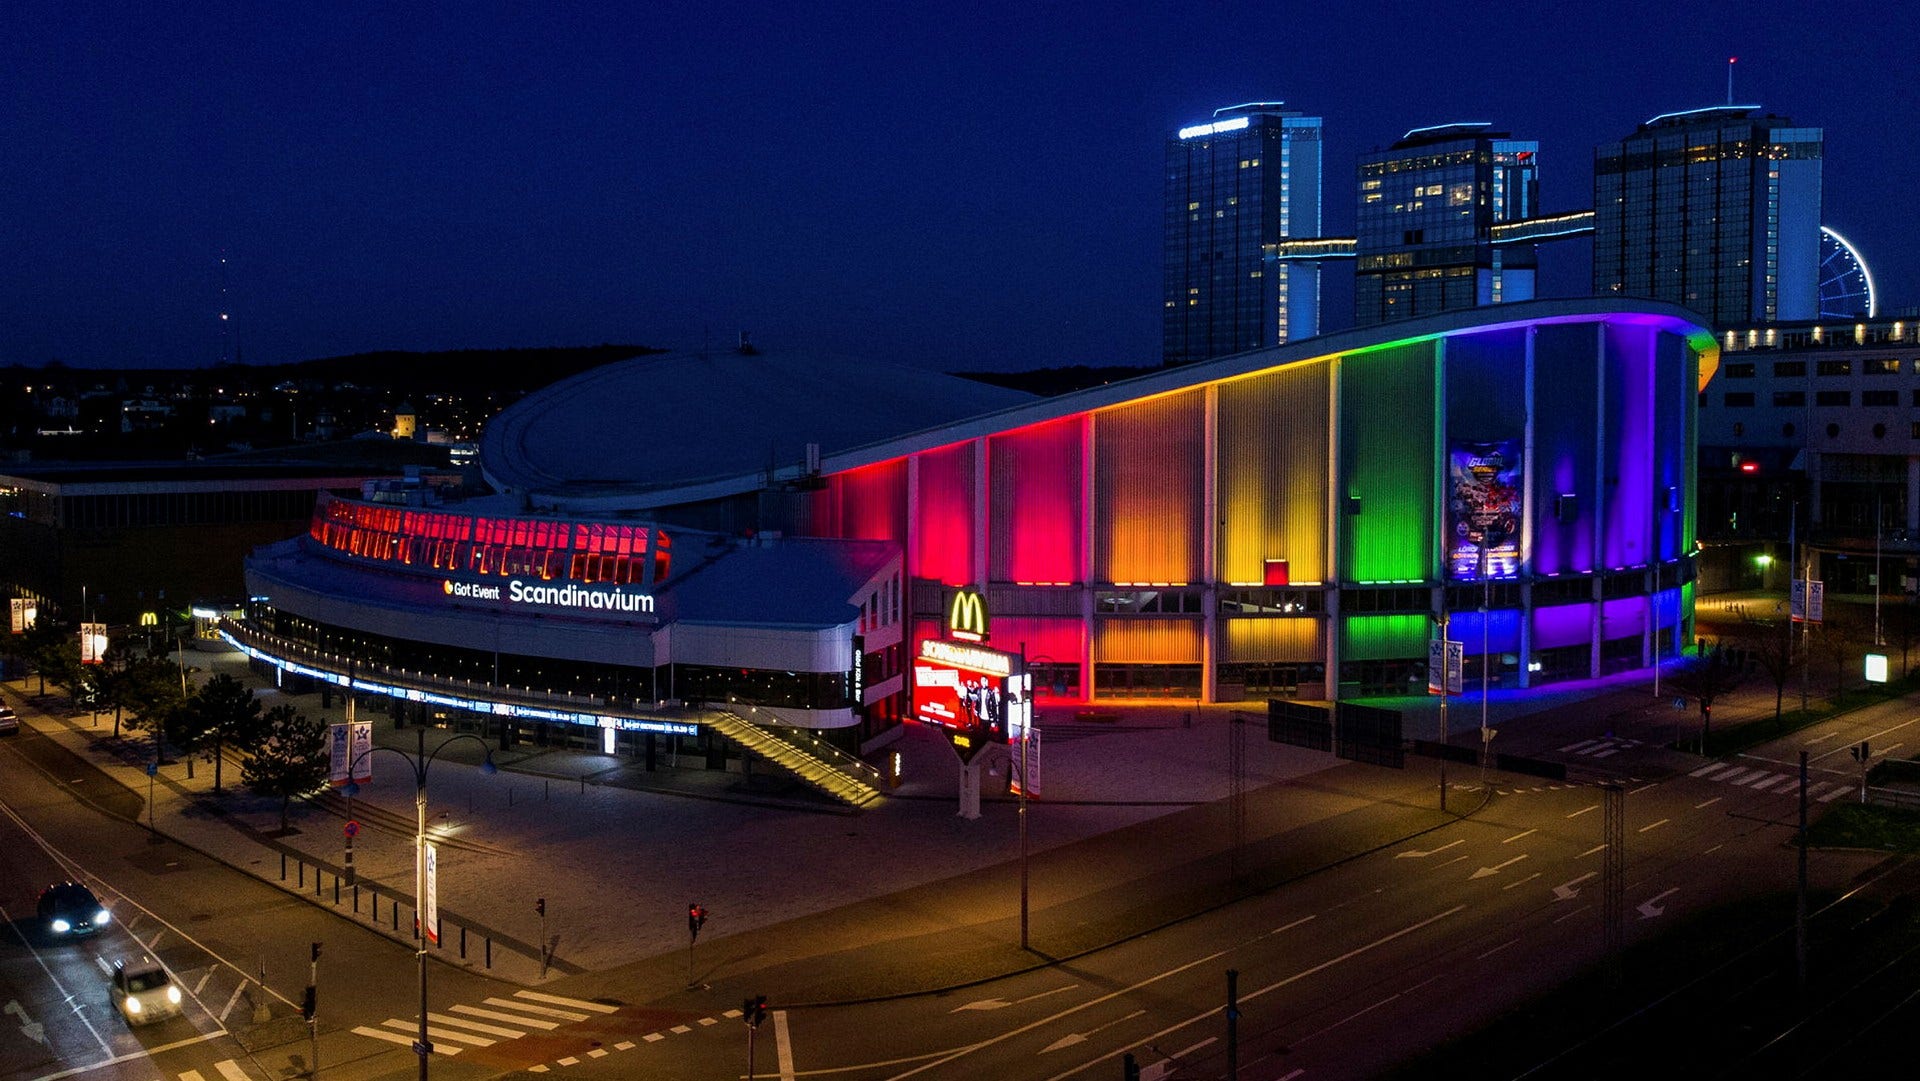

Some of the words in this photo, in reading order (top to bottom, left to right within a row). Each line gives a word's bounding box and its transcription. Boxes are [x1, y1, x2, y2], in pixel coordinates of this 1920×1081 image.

[454, 582, 471, 598] Got
[472, 584, 500, 600] Event
[509, 580, 655, 612] Scandinavium
